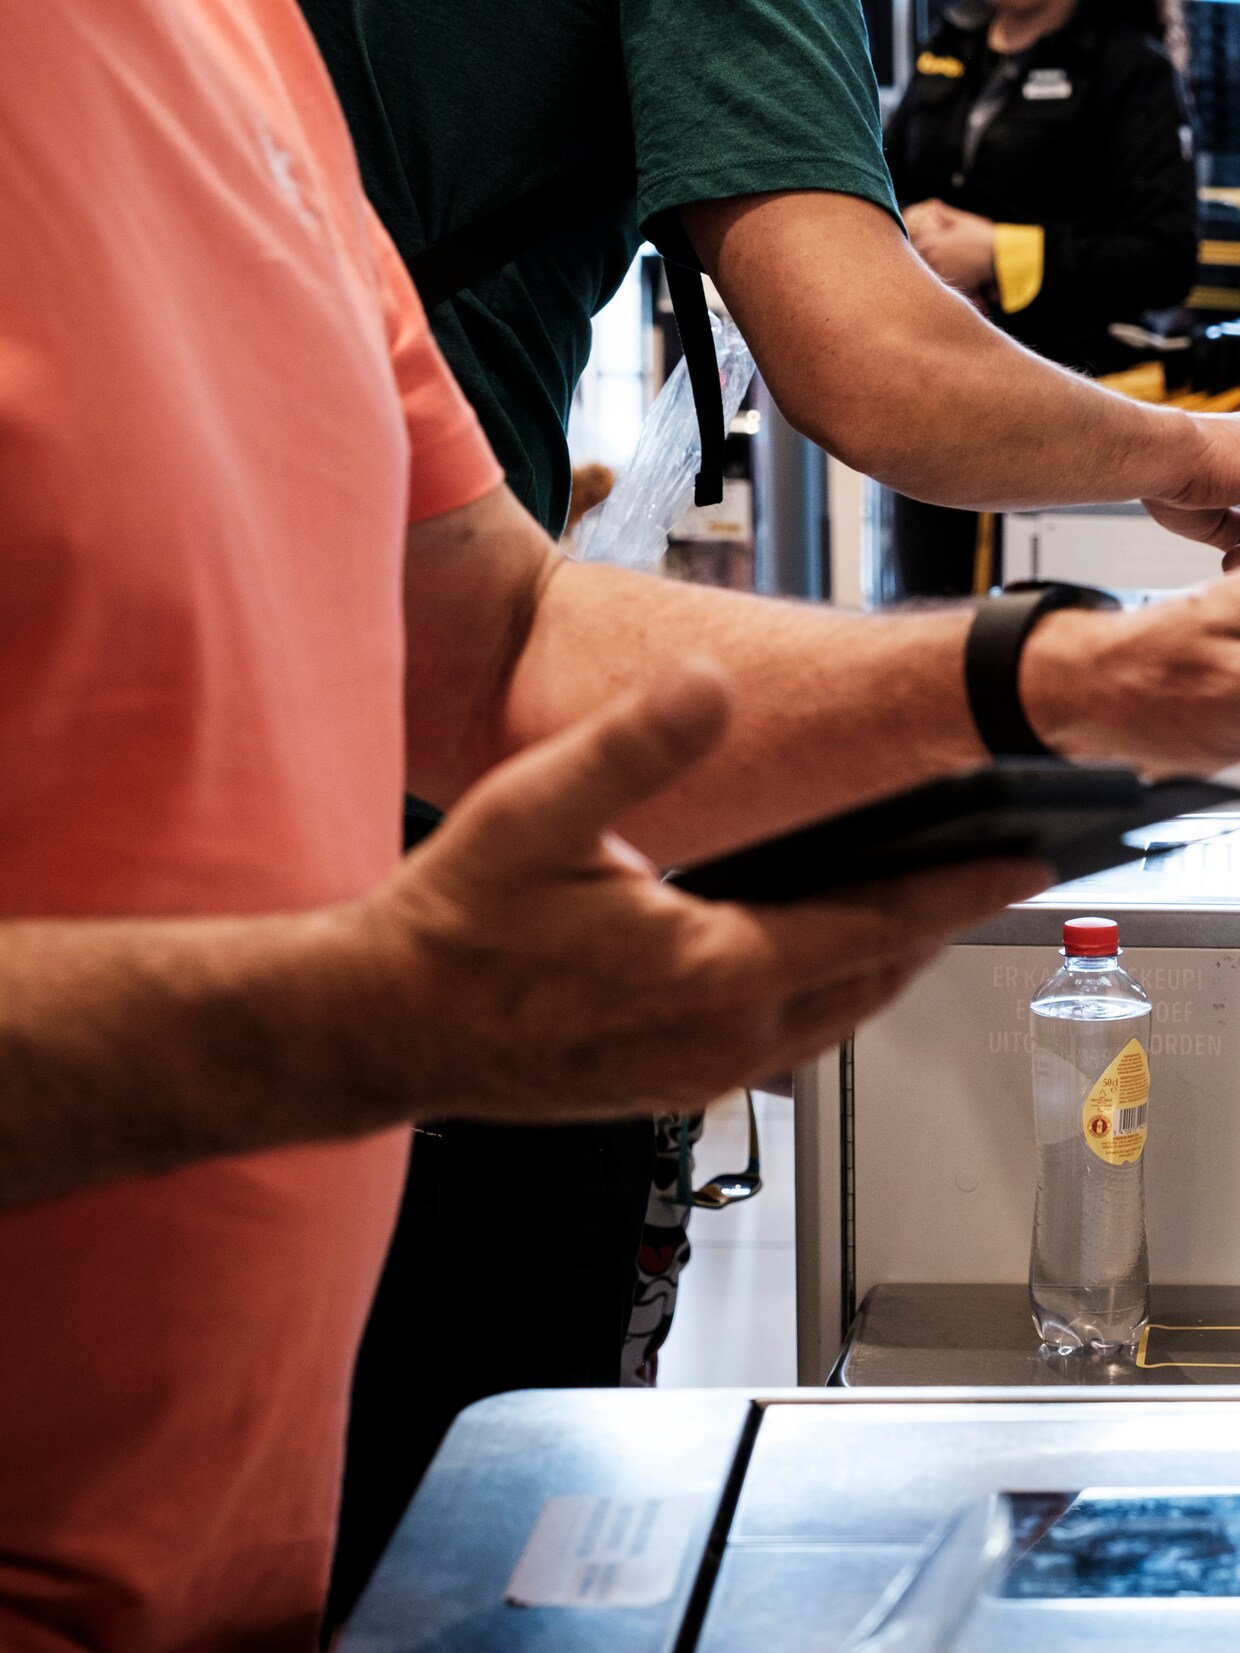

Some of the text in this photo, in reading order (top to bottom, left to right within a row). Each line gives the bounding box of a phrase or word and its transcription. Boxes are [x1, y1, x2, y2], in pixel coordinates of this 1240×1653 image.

[992, 966, 1018, 988] ER
[1154, 1000, 1195, 1024] OEF
[1150, 1032, 1222, 1056] ORDEN
